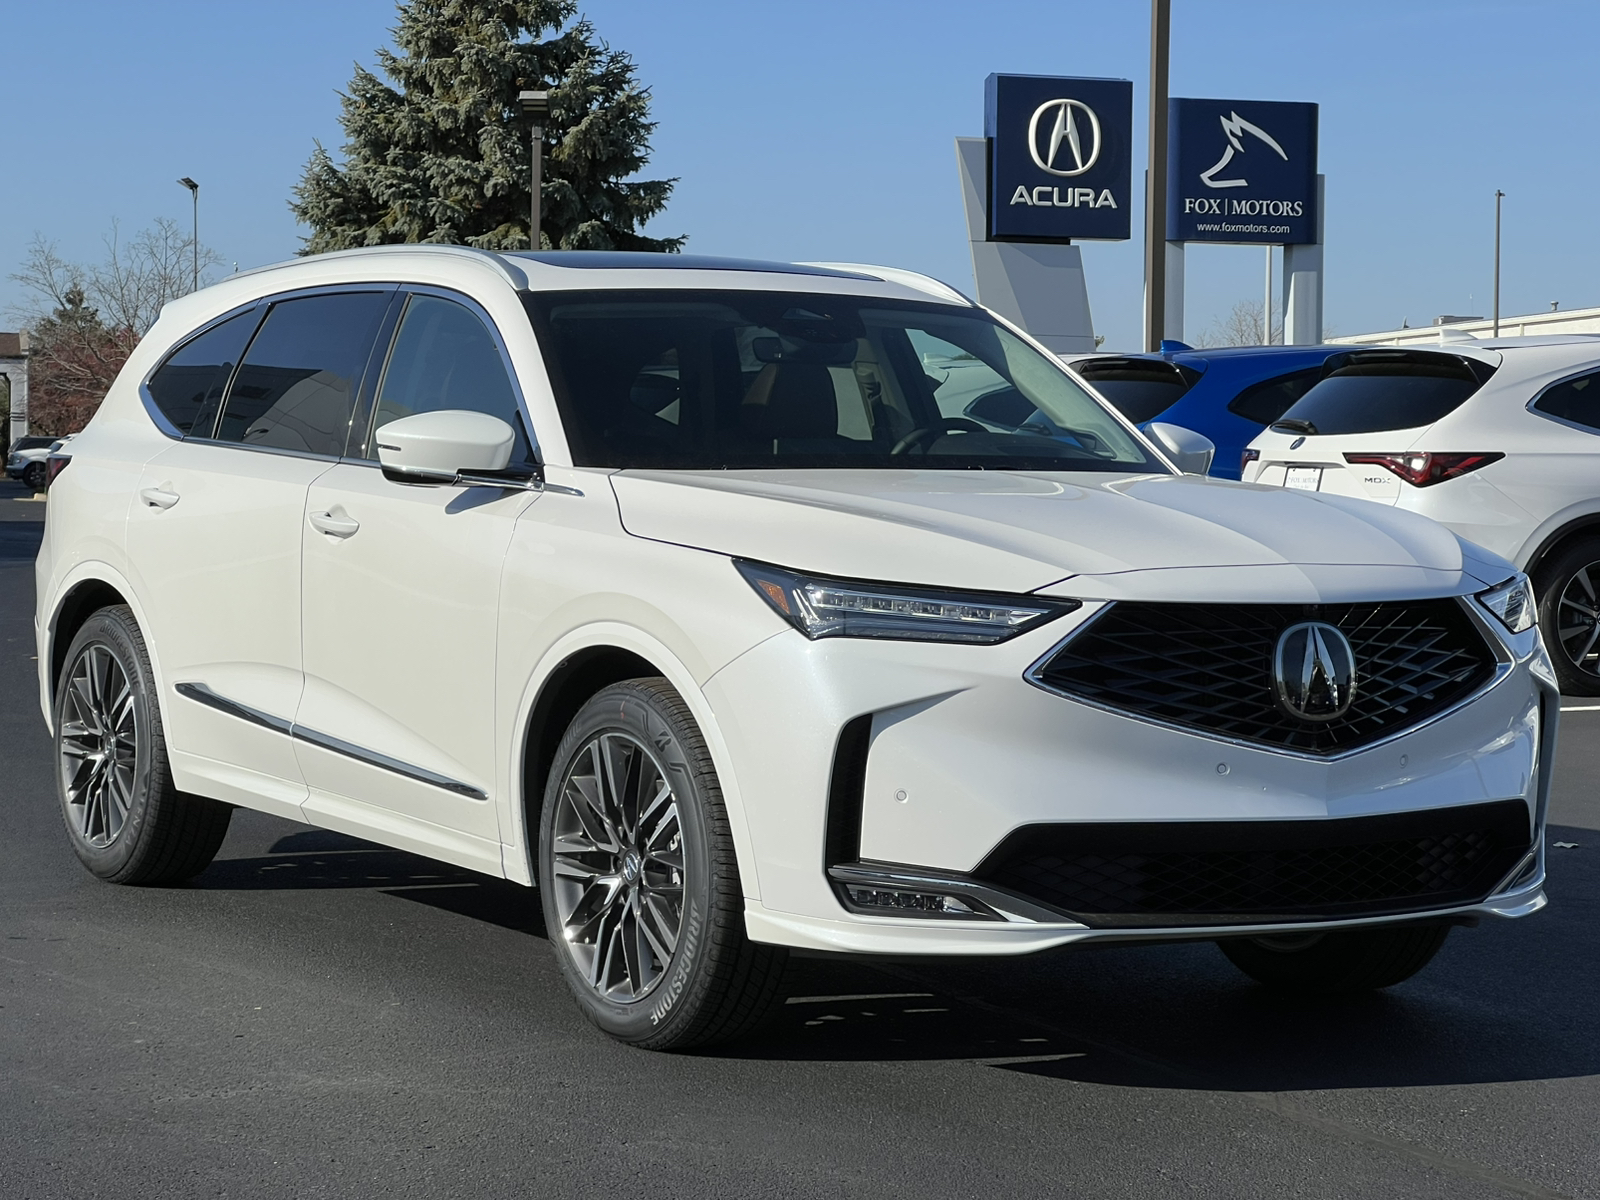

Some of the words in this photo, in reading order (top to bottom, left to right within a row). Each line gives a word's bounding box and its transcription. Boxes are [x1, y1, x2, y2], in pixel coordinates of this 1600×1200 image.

[1009, 185, 1118, 209] ACURA
[1184, 198, 1221, 214] FOX
[1231, 199, 1303, 216] MOTORS
[1197, 222, 1290, 233] www.foxmotors.com
[650, 896, 704, 1026] BRIDGESTONE
